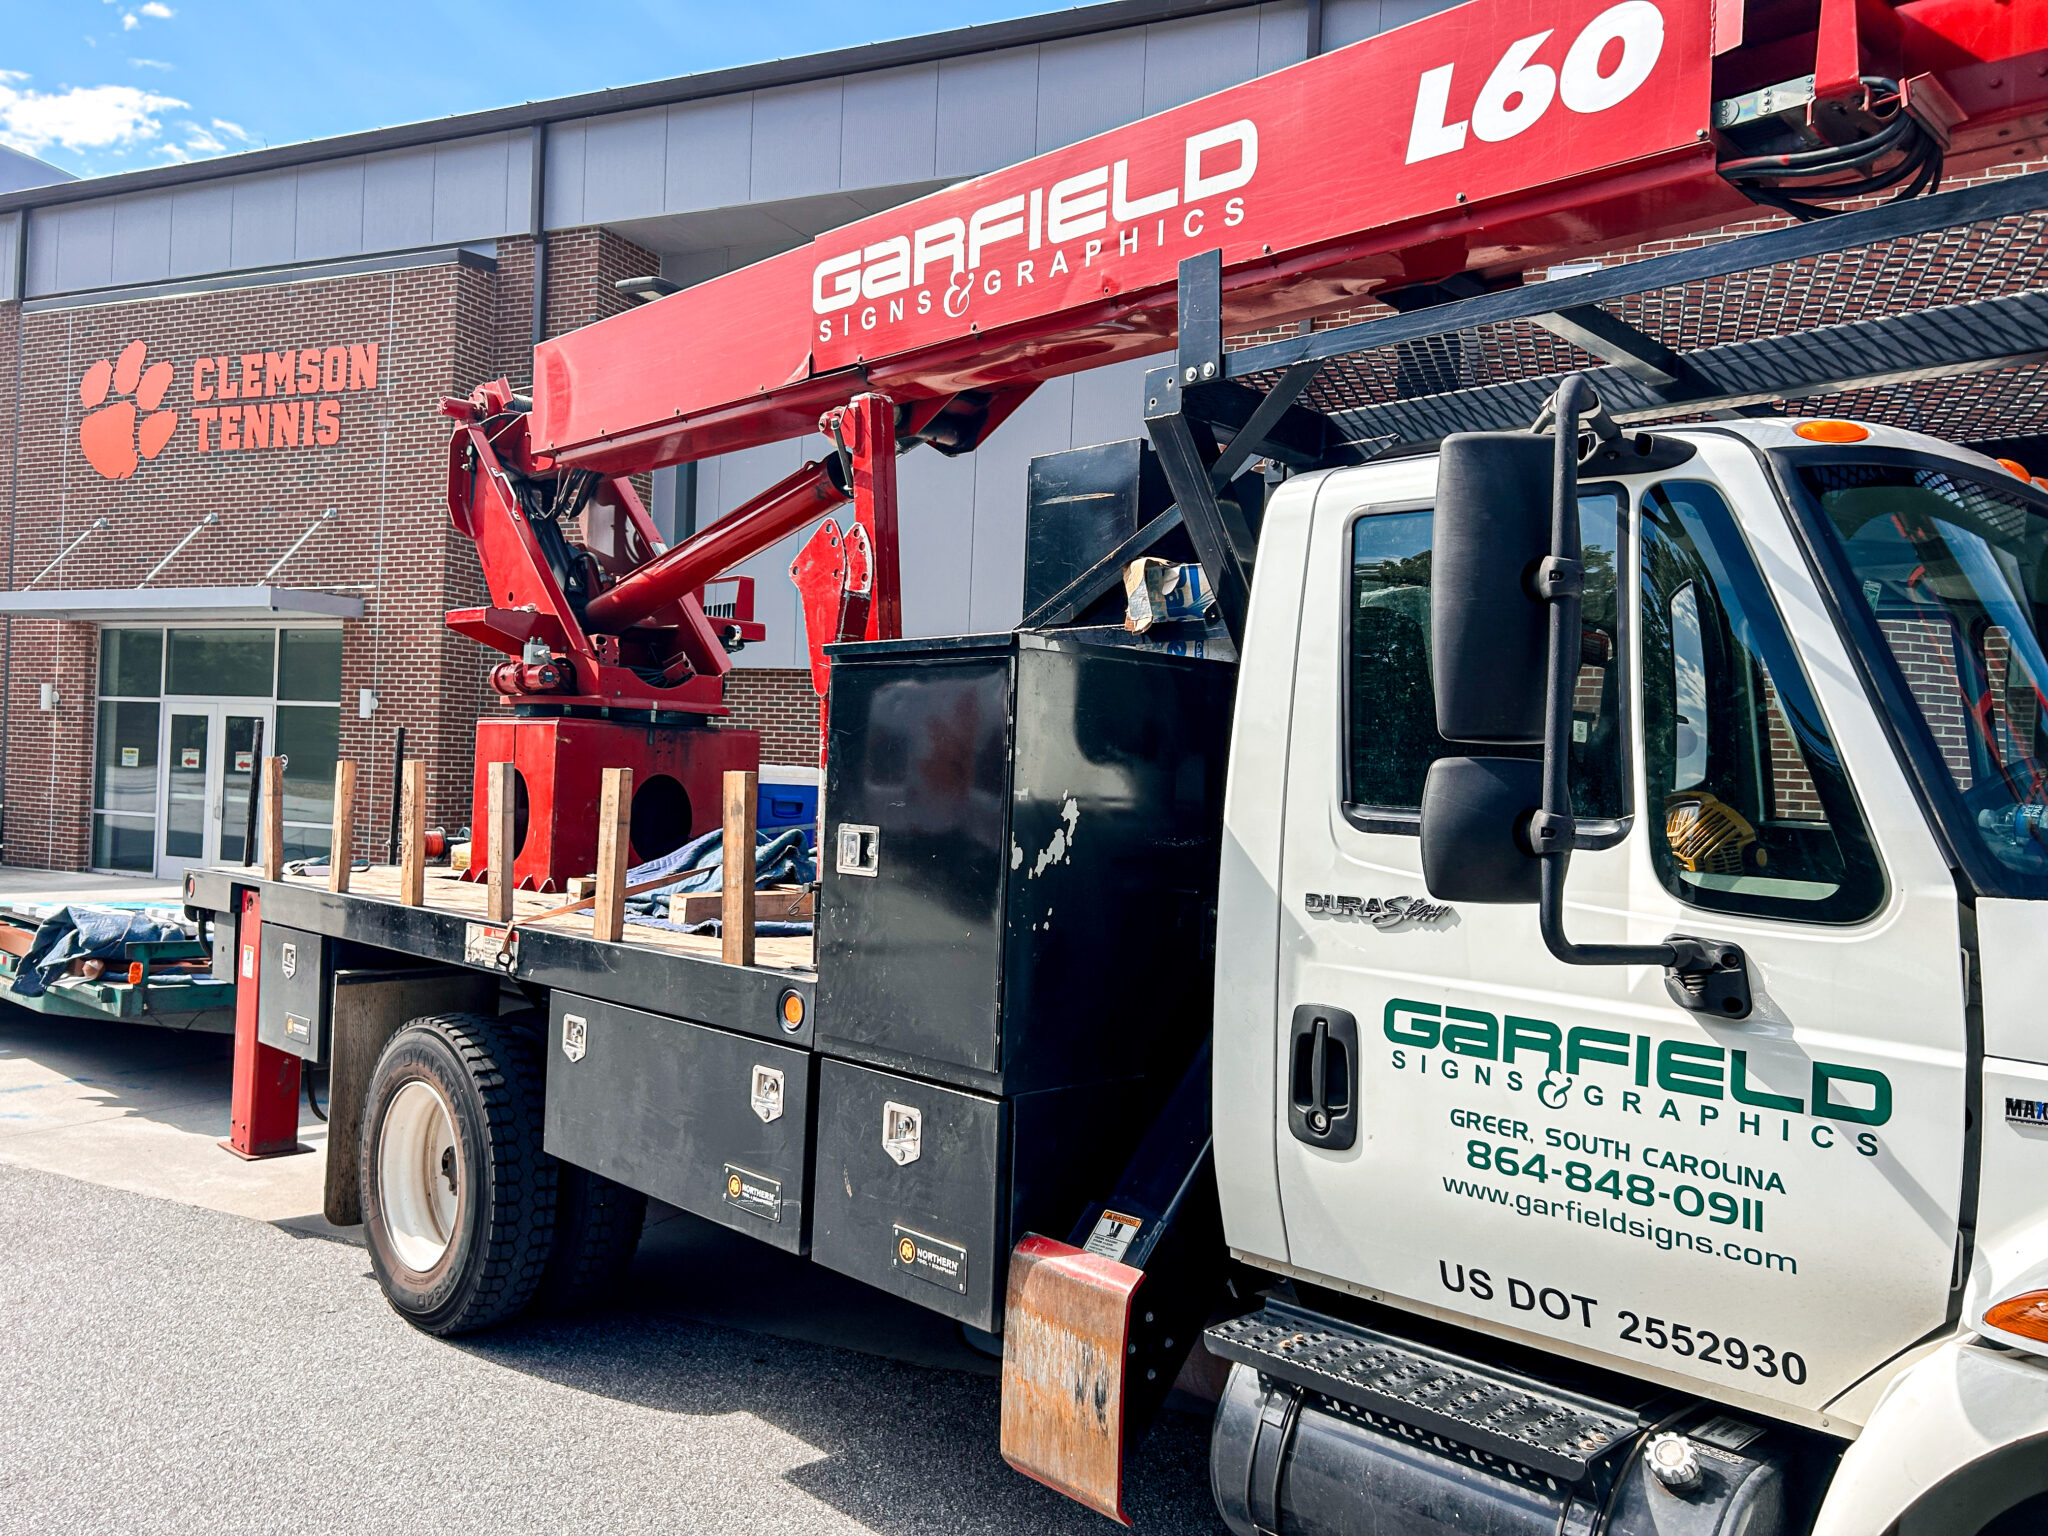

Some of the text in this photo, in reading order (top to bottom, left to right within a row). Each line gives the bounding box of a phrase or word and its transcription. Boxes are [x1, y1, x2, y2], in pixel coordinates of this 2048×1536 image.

[1405, 0, 1666, 165] L60
[819, 197, 1245, 343] SIGNS & GRAPHICS
[192, 343, 379, 400] CLEMSON
[191, 399, 342, 452] TENNIS
[1391, 1049, 1880, 1157] SIGNS & GRAPHICS
[741, 1182, 776, 1202] NORTHERN
[1449, 1107, 1787, 1195] GREER, SOUTH CAROLINA
[1466, 1138, 1764, 1233] 864-848-0911
[916, 1248, 959, 1271] NORTHERN
[1442, 1175, 1798, 1275] www.garfieldsigns.com
[1438, 1259, 1808, 1387] US DOT 2552930
